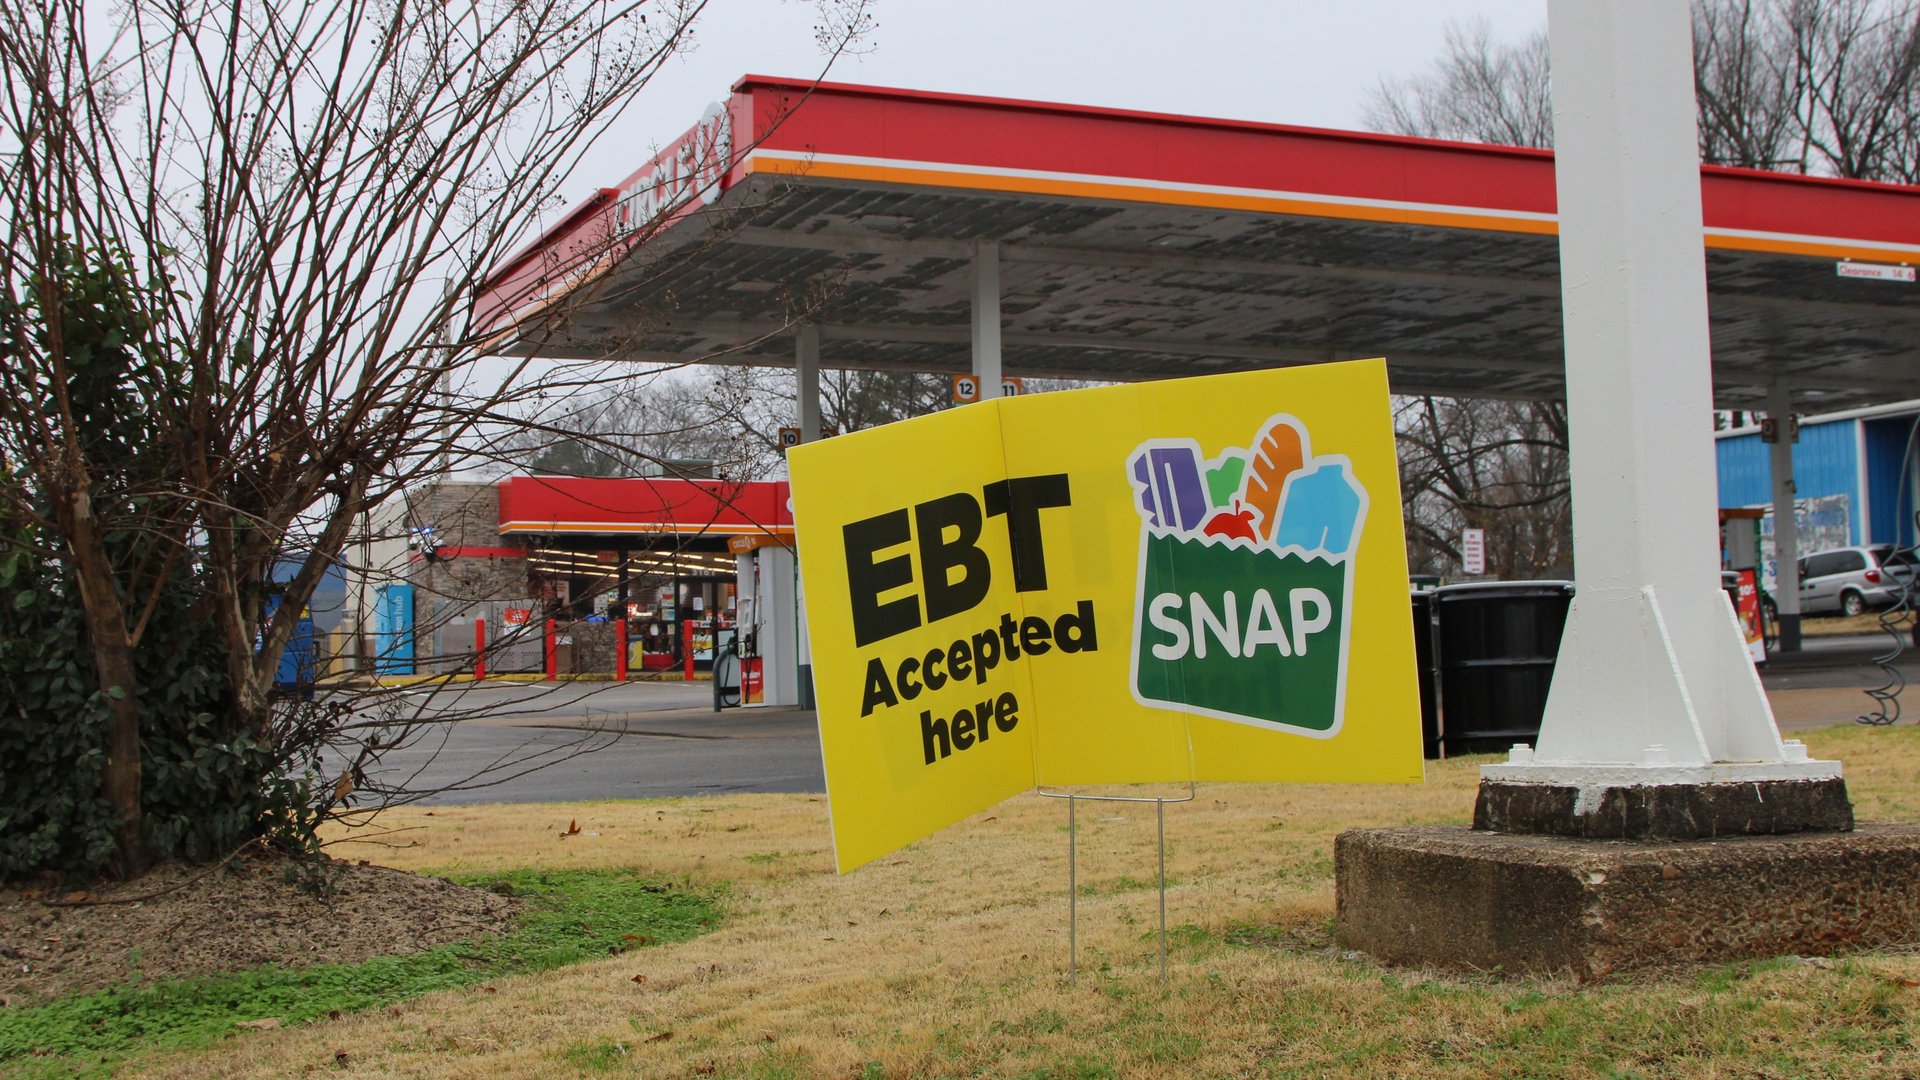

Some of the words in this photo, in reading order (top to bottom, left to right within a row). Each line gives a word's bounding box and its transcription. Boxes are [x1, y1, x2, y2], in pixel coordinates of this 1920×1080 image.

[615, 141, 695, 238] CIRCLE
[1840, 265, 1881, 276] Clearance
[958, 382, 974, 395] 12
[1002, 384, 1015, 397] 11
[782, 434, 796, 445] 10
[842, 473, 1071, 649] EBT
[394, 596, 403, 615] hub
[395, 616, 403, 649] zon
[1149, 588, 1332, 661] SNAP
[861, 600, 1098, 718] Accepted
[920, 692, 1019, 765] here
